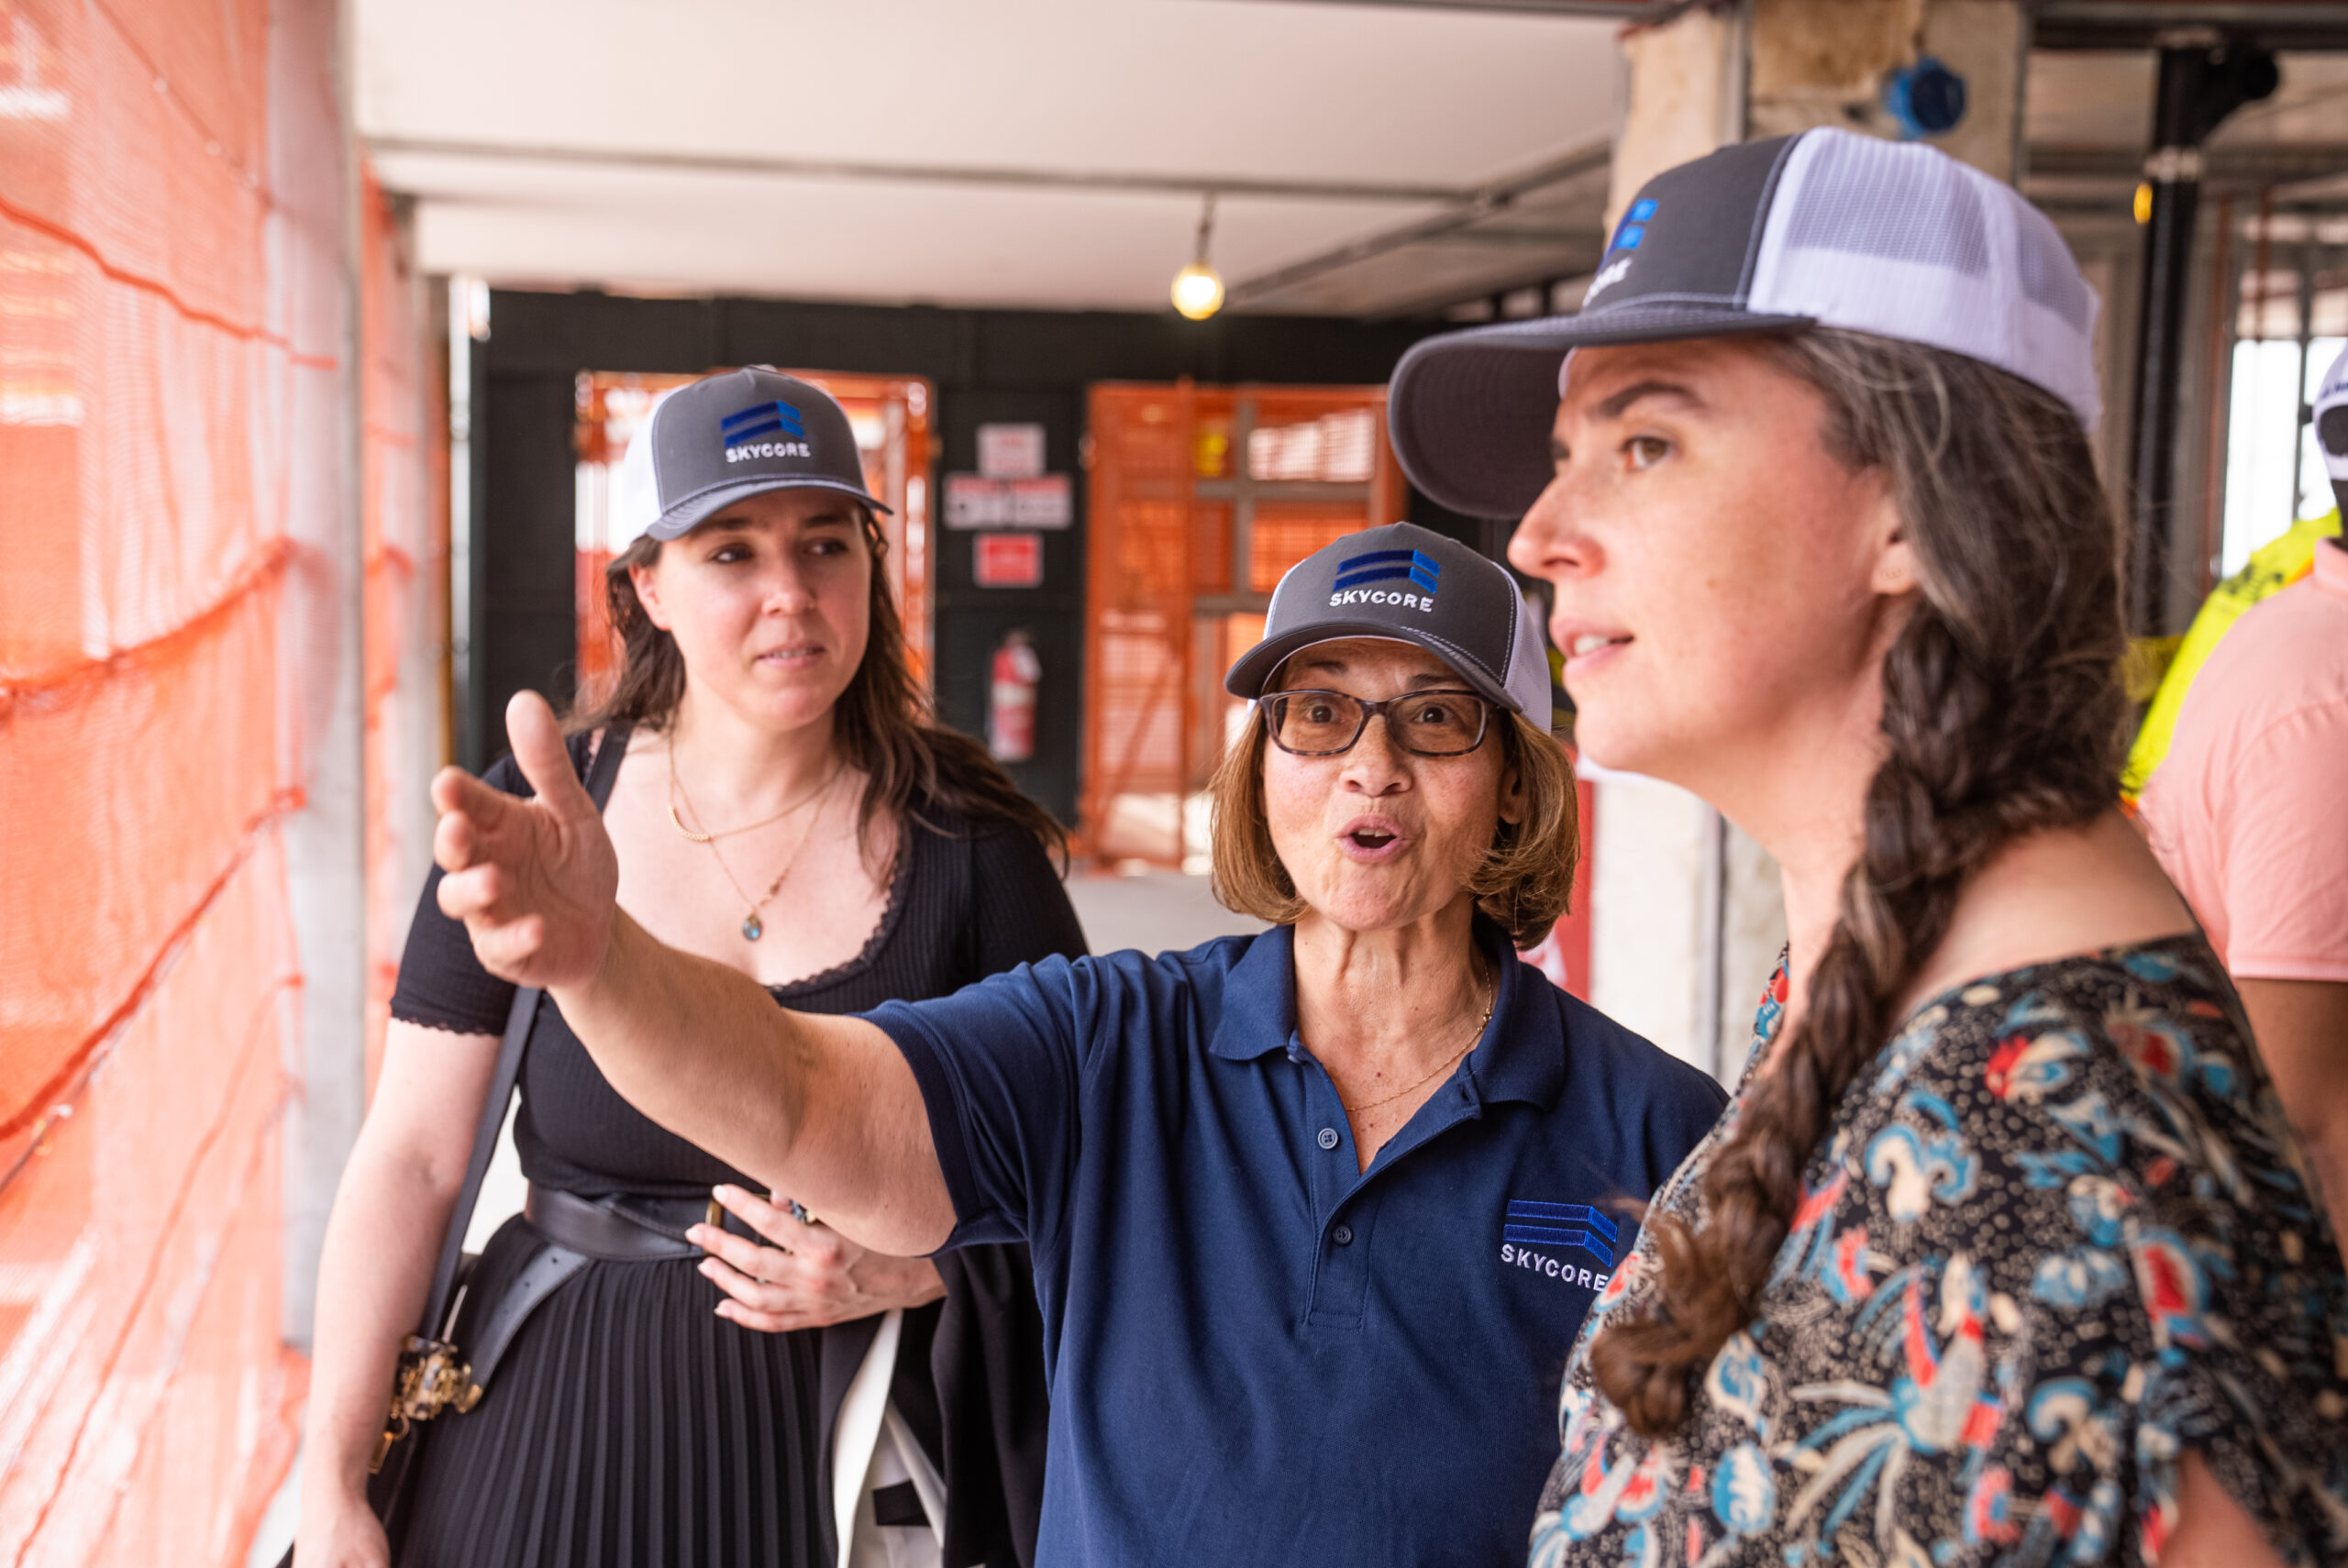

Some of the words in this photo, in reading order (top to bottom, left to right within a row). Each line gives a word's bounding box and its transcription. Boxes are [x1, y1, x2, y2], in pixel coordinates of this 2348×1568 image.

[725, 442, 811, 463] SKYCORE
[1329, 589, 1434, 612] SKYCORE
[1501, 1243, 1609, 1291] SKYCORE
